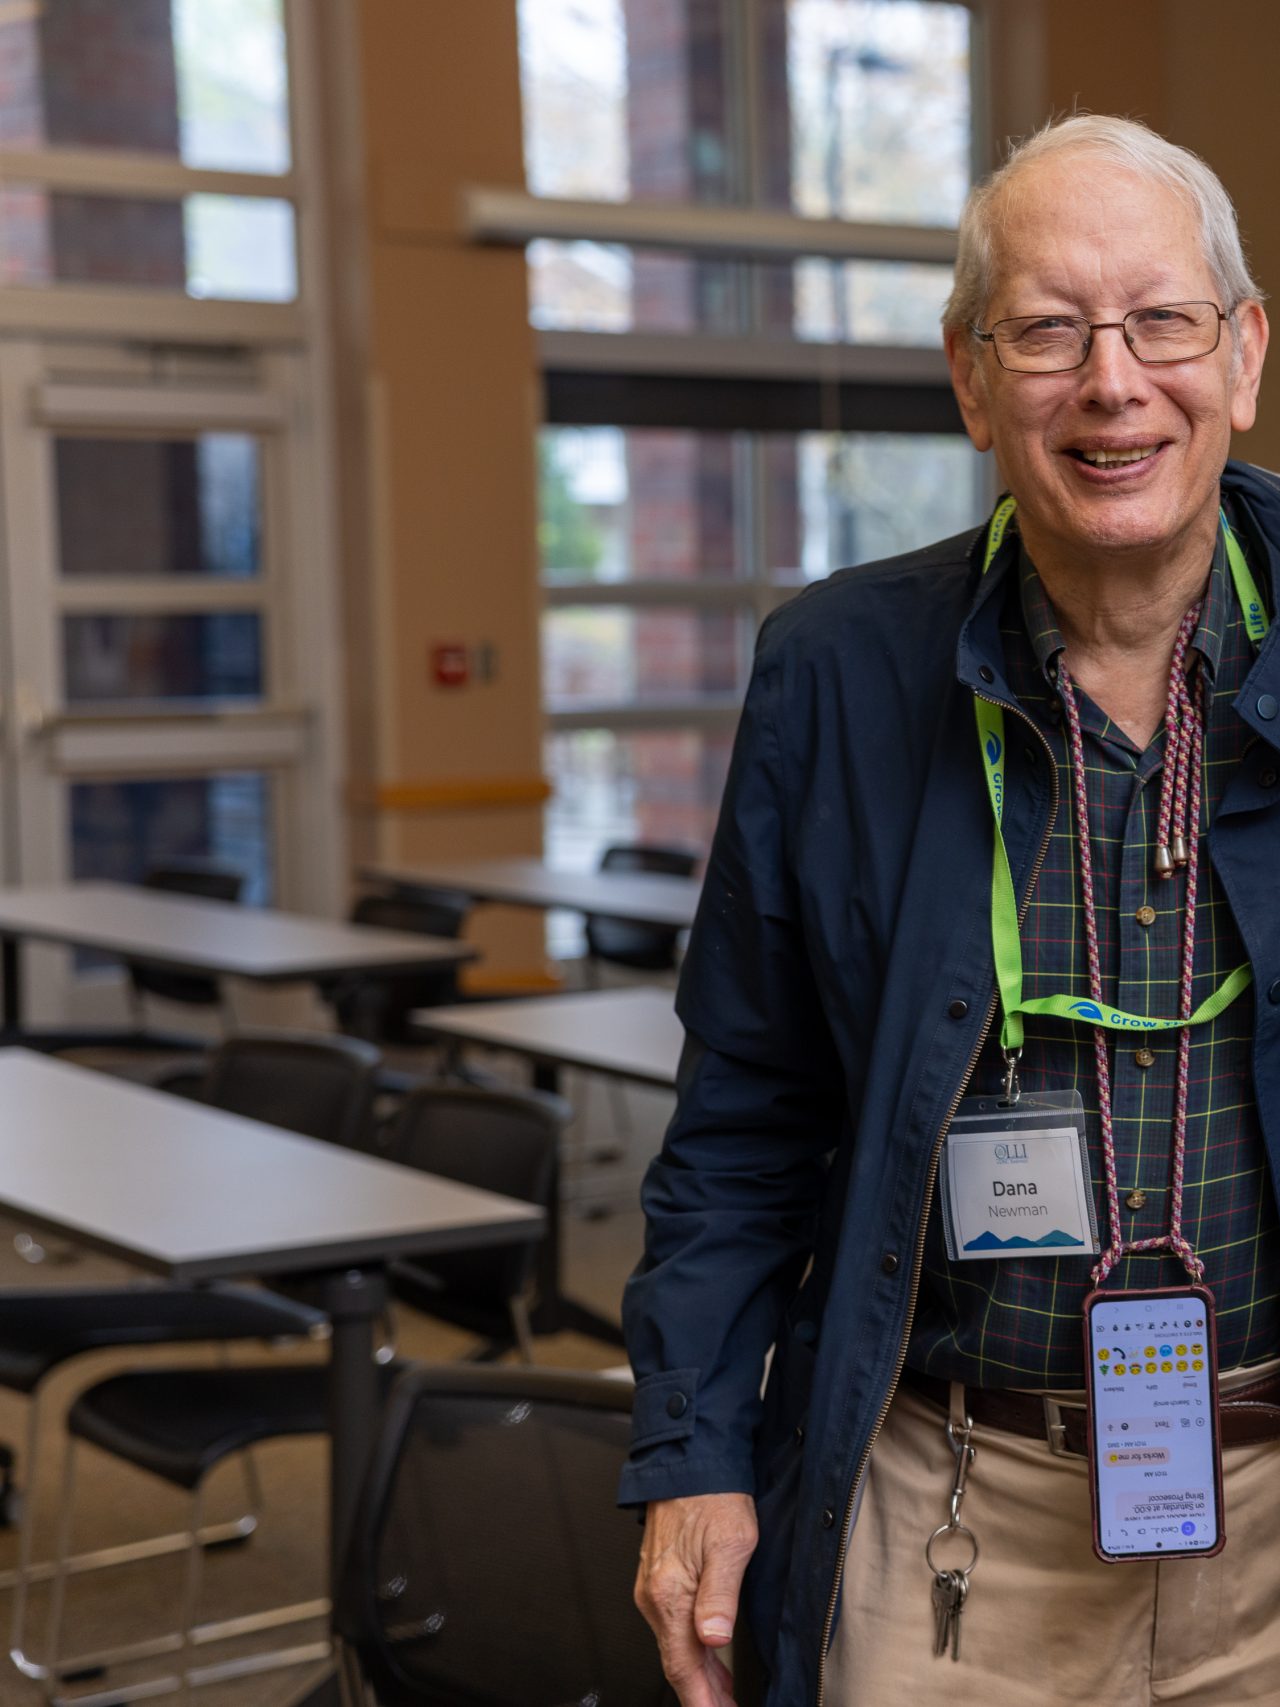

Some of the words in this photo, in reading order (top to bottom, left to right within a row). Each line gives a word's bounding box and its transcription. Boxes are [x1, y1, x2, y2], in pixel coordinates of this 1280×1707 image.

[1110, 1013, 1157, 1028] Grow
[992, 1181, 1038, 1196] Dana
[988, 1205, 1049, 1218] Newman
[1148, 1494, 1184, 1503] Prosecco!
[1185, 1492, 1205, 1501] Bring
[1162, 1502, 1194, 1512] Saturday
[1161, 1525, 1179, 1534] Carol
